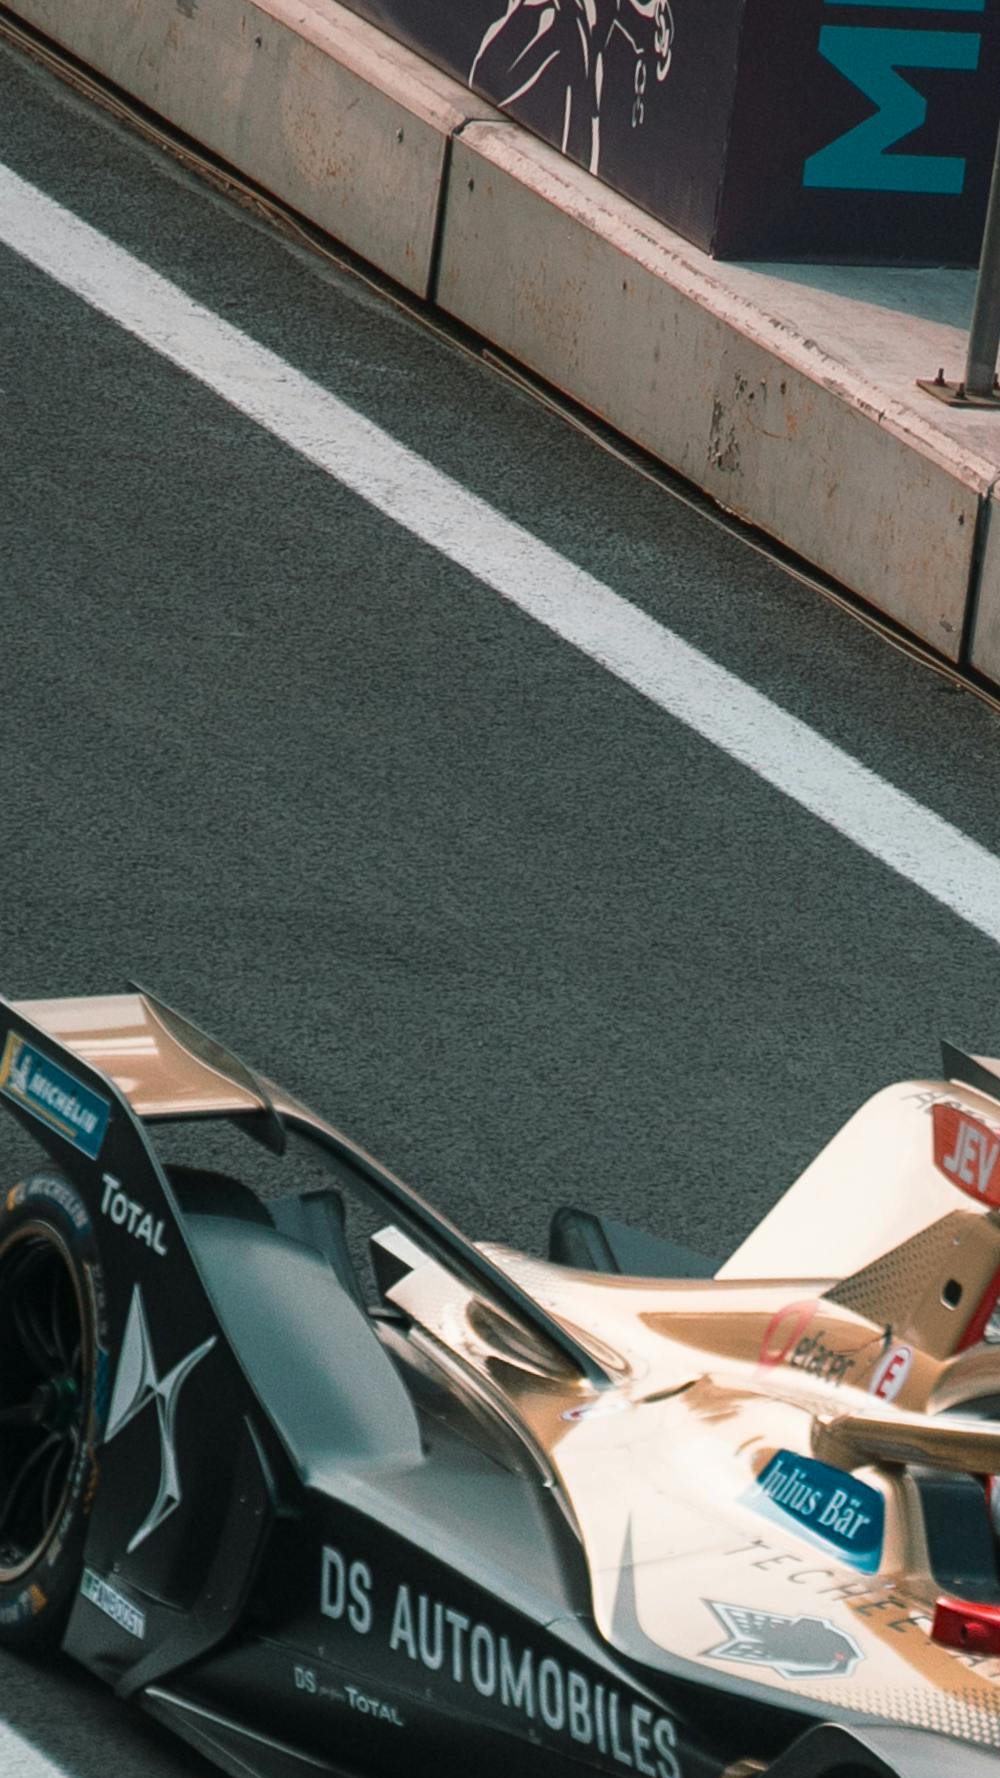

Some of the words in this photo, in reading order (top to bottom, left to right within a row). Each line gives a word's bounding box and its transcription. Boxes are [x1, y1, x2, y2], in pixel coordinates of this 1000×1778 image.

[28, 1072, 99, 1135] MICHELIN
[943, 1120, 1000, 1194] JEV
[101, 1173, 167, 1257] TOTAL
[762, 1460, 823, 1516] Julius
[818, 1488, 872, 1540] Bär
[320, 1546, 372, 1635] DS
[294, 1666, 316, 1693] DS
[344, 1686, 404, 1726] TOTAL
